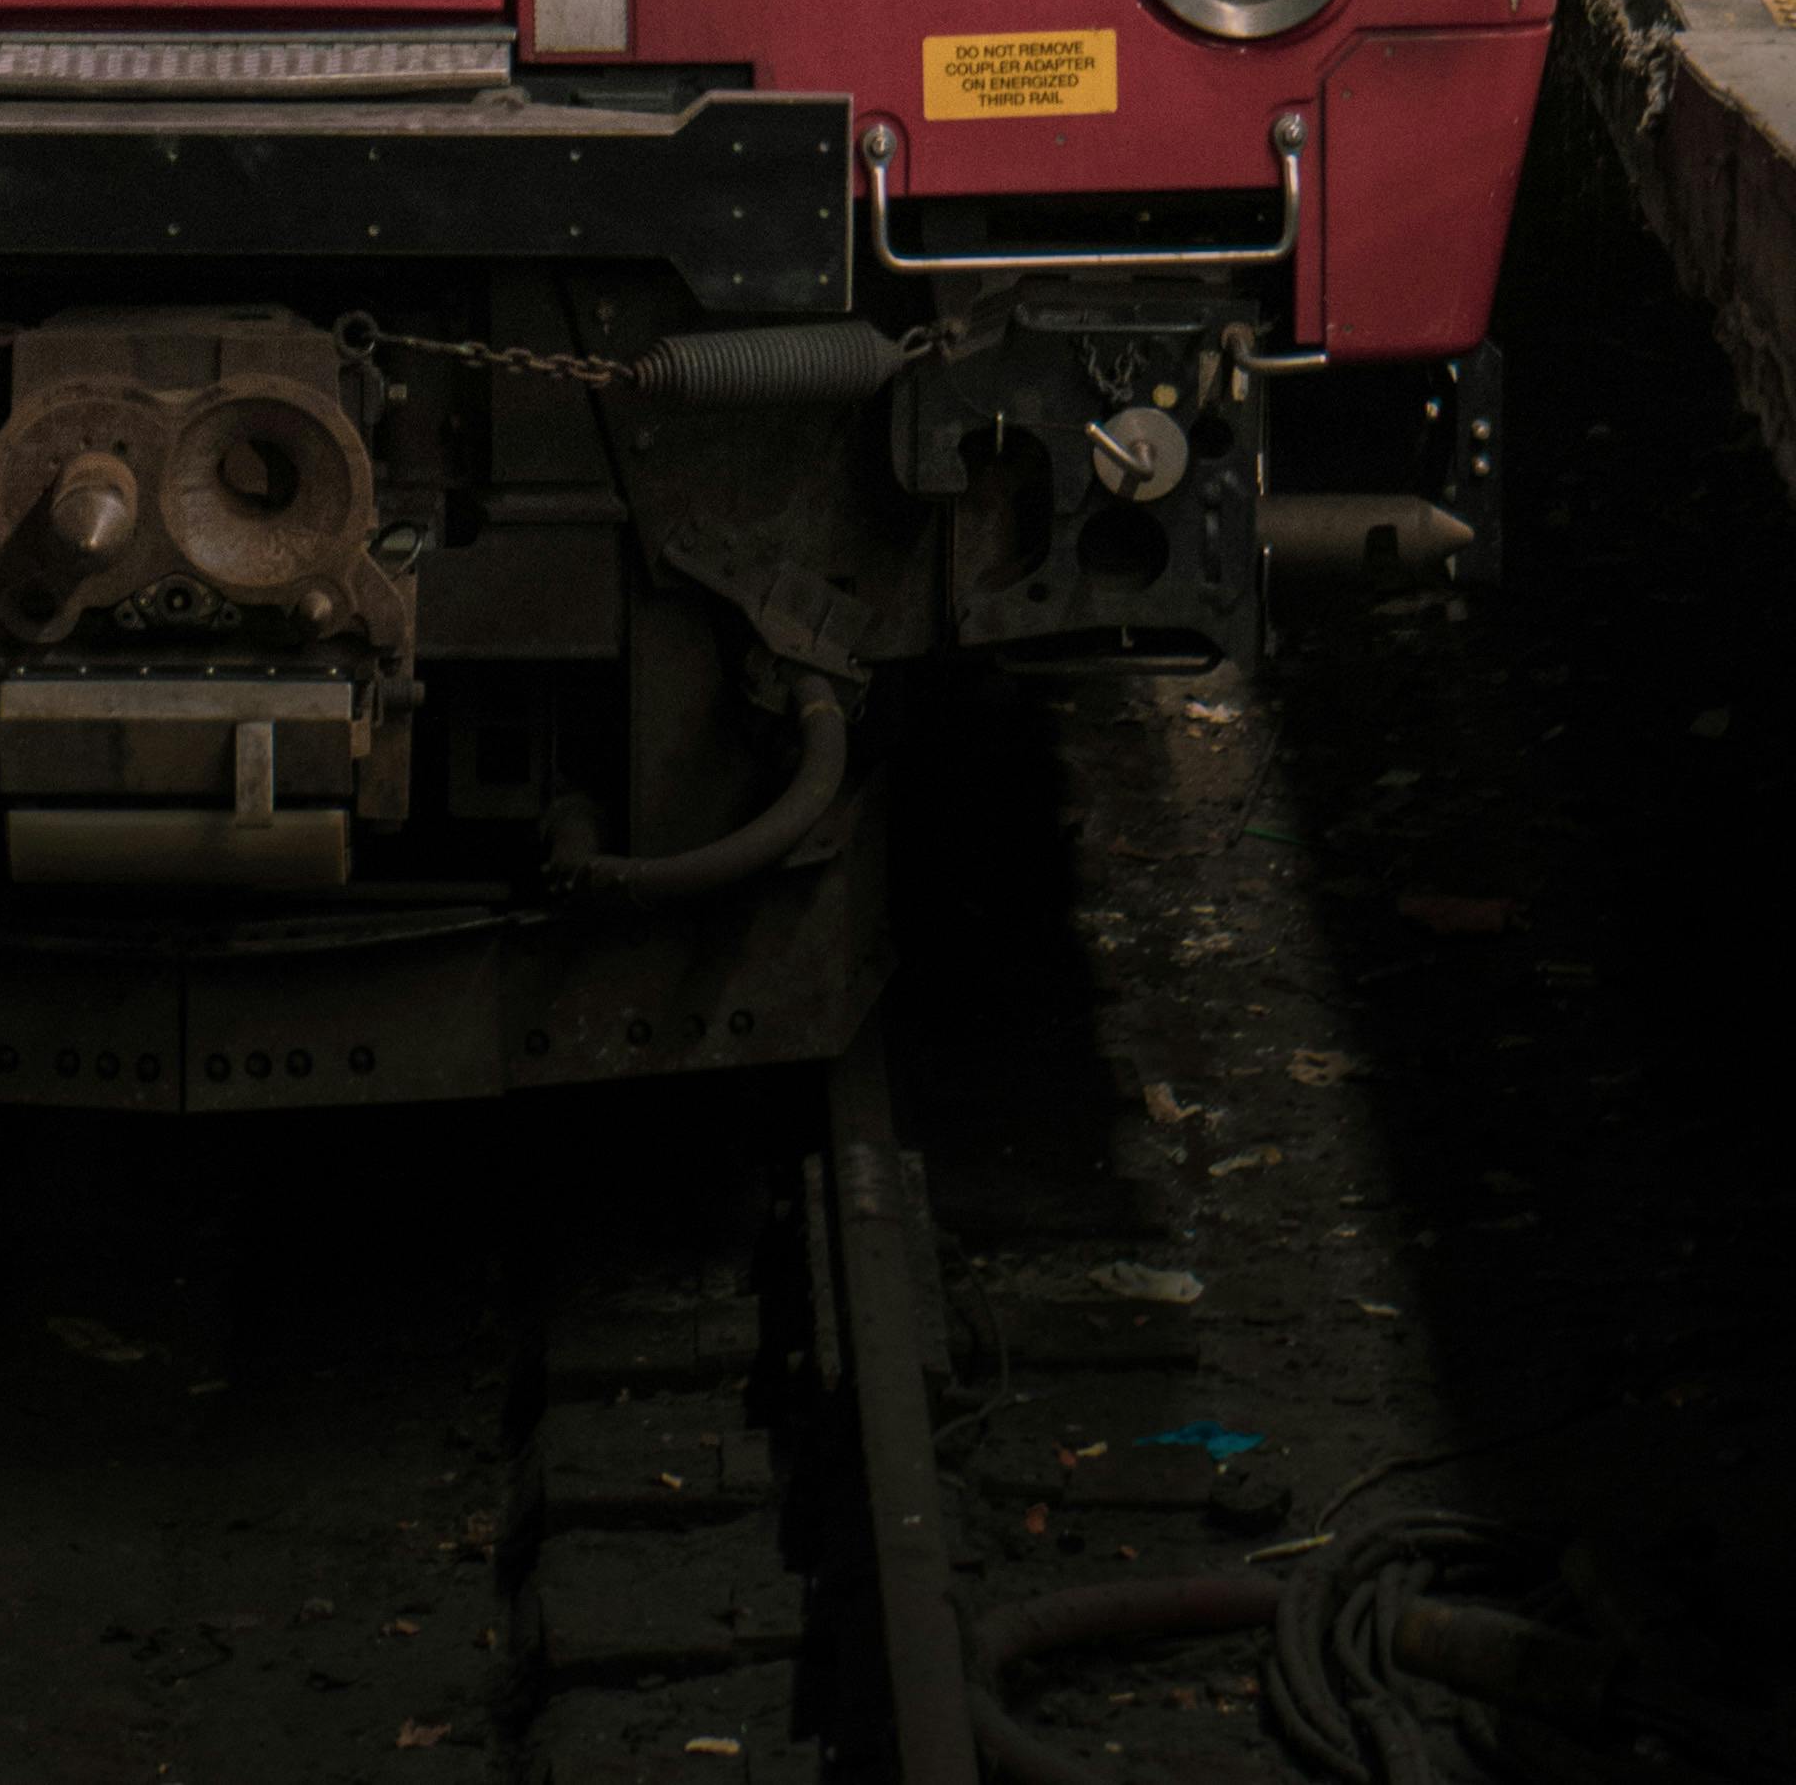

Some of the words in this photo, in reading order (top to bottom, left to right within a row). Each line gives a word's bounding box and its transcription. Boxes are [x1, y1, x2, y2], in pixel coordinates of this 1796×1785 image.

[956, 45, 979, 60] DO
[983, 44, 1015, 58] NOT
[1019, 41, 1083, 56] REMOVE
[945, 59, 1020, 77] COUPLER
[1024, 56, 1096, 73] ADAPTER
[962, 78, 985, 92] ON
[990, 74, 1079, 91] ENERGIZED
[979, 92, 1026, 108] THIRD
[1029, 90, 1063, 105] RAIL
